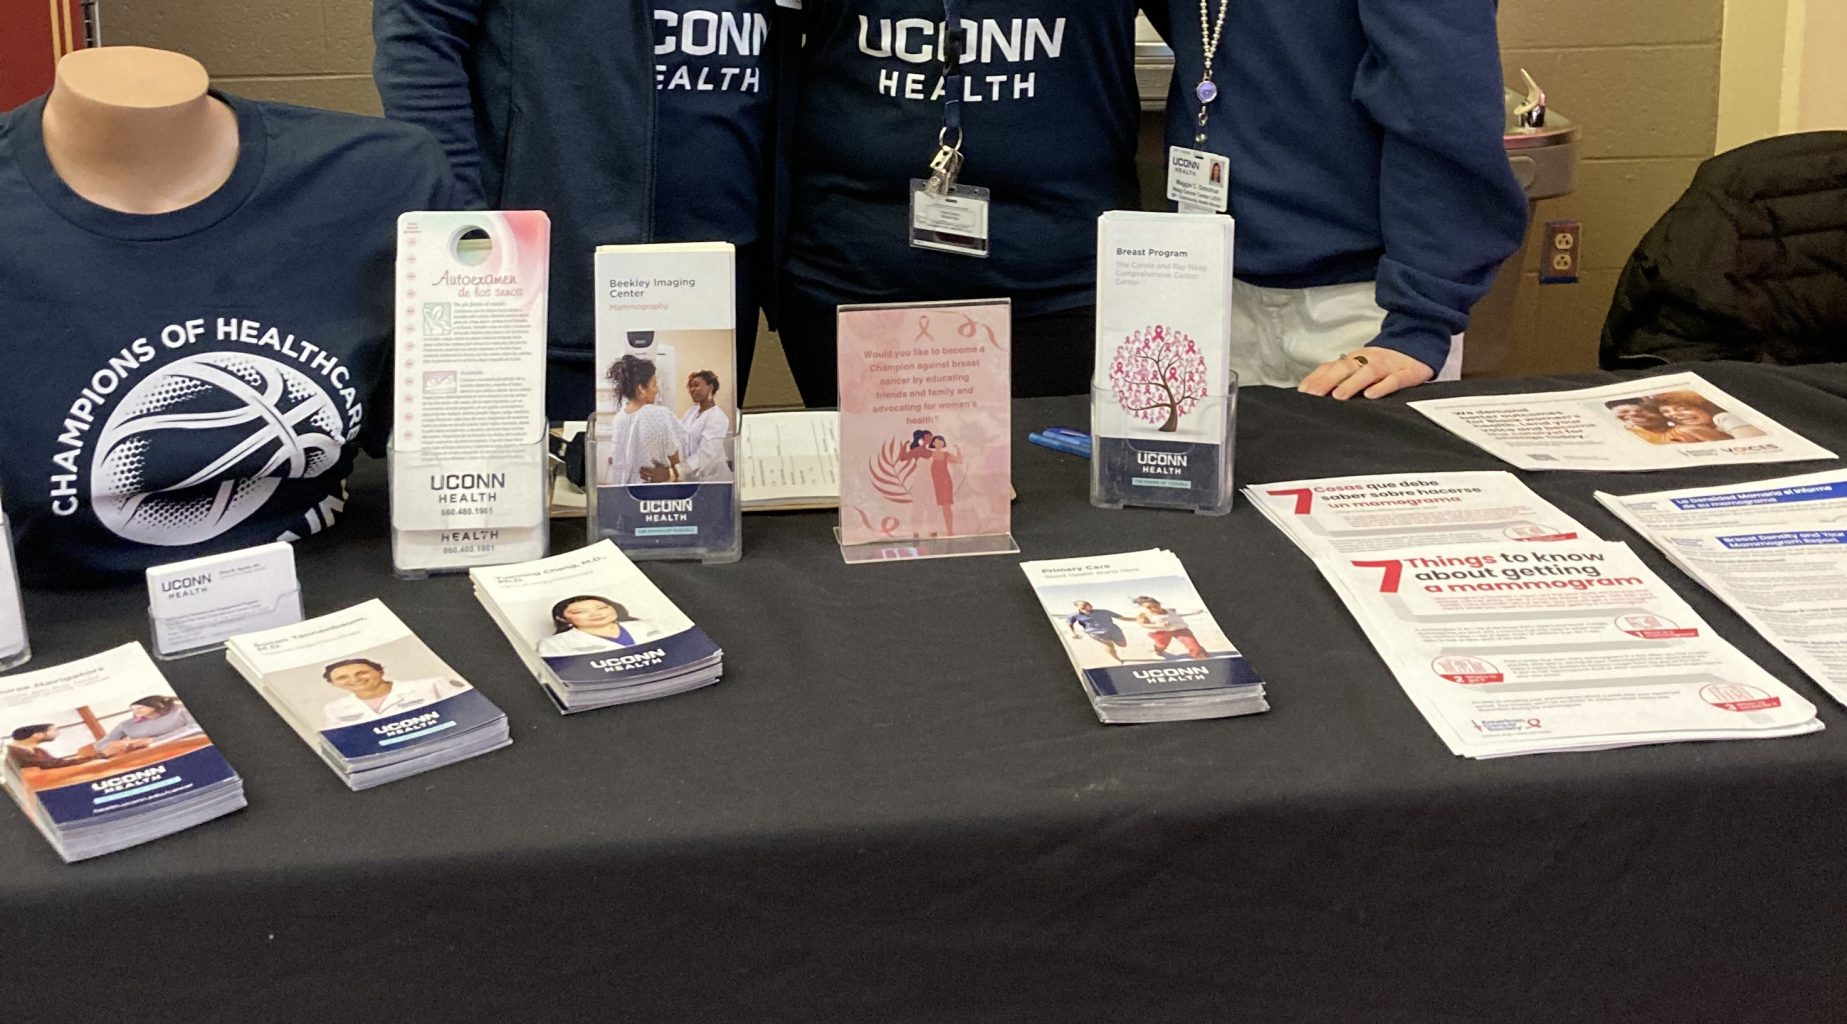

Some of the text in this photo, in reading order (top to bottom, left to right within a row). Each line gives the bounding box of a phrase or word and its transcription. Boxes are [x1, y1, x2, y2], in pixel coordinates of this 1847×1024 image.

[654, 9, 768, 56] CONN
[858, 14, 1067, 65] UCONN
[656, 65, 760, 93] EALTH
[1173, 157, 1200, 170] UCONN
[1116, 247, 1188, 258] Breast Program
[432, 270, 517, 286] Autoexamen
[609, 278, 696, 289] Beekley Imaging
[458, 287, 523, 297] de los senos
[609, 289, 645, 298] Center
[864, 350, 892, 359] Would
[894, 350, 911, 359] you
[913, 348, 929, 356] like
[931, 348, 941, 356] to
[942, 346, 978, 355] become
[869, 359, 980, 373] Champion against breast
[880, 373, 970, 386] cancer by educating
[876, 386, 974, 399] friends and family and
[872, 403, 921, 414] advocating
[923, 401, 936, 410] for
[51, 338, 156, 516] CHAMPIONS
[161, 318, 205, 349] OF
[217, 317, 363, 442] HEALTHCARE
[906, 415, 939, 425] health?
[1137, 453, 1187, 466] UCONN
[1142, 466, 1182, 475] HEALTH
[430, 473, 505, 490] UCONN
[439, 492, 497, 504] HEALTH
[1266, 478, 1439, 514] 7 Cosas que debe
[1321, 485, 1482, 502] saber sobre hacerse
[1690, 495, 1736, 503] Densidad
[1738, 490, 1782, 499] Mamaria
[639, 499, 693, 513] UCONN
[1329, 495, 1462, 510] un mamograma
[1712, 497, 1777, 507] mamograma
[645, 513, 687, 522] HEALTH
[441, 530, 499, 542] HEALTH
[1758, 533, 1798, 542] Density
[1729, 539, 1802, 548] Mammogram
[1041, 566, 1082, 574] Primary
[1351, 550, 1605, 593] 7 Things to know
[1415, 564, 1600, 581] about getting
[162, 573, 212, 592] UCONN
[1424, 575, 1643, 593] a mammogram
[168, 587, 208, 599] HEALTH
[590, 648, 666, 669] UCONN
[605, 658, 662, 673] HEALTH
[1132, 665, 1210, 680] UCONN
[1146, 674, 1206, 684] HEALTH
[373, 711, 440, 734] UCONN
[387, 720, 437, 737] HEALTH
[91, 765, 167, 791] UCONN
